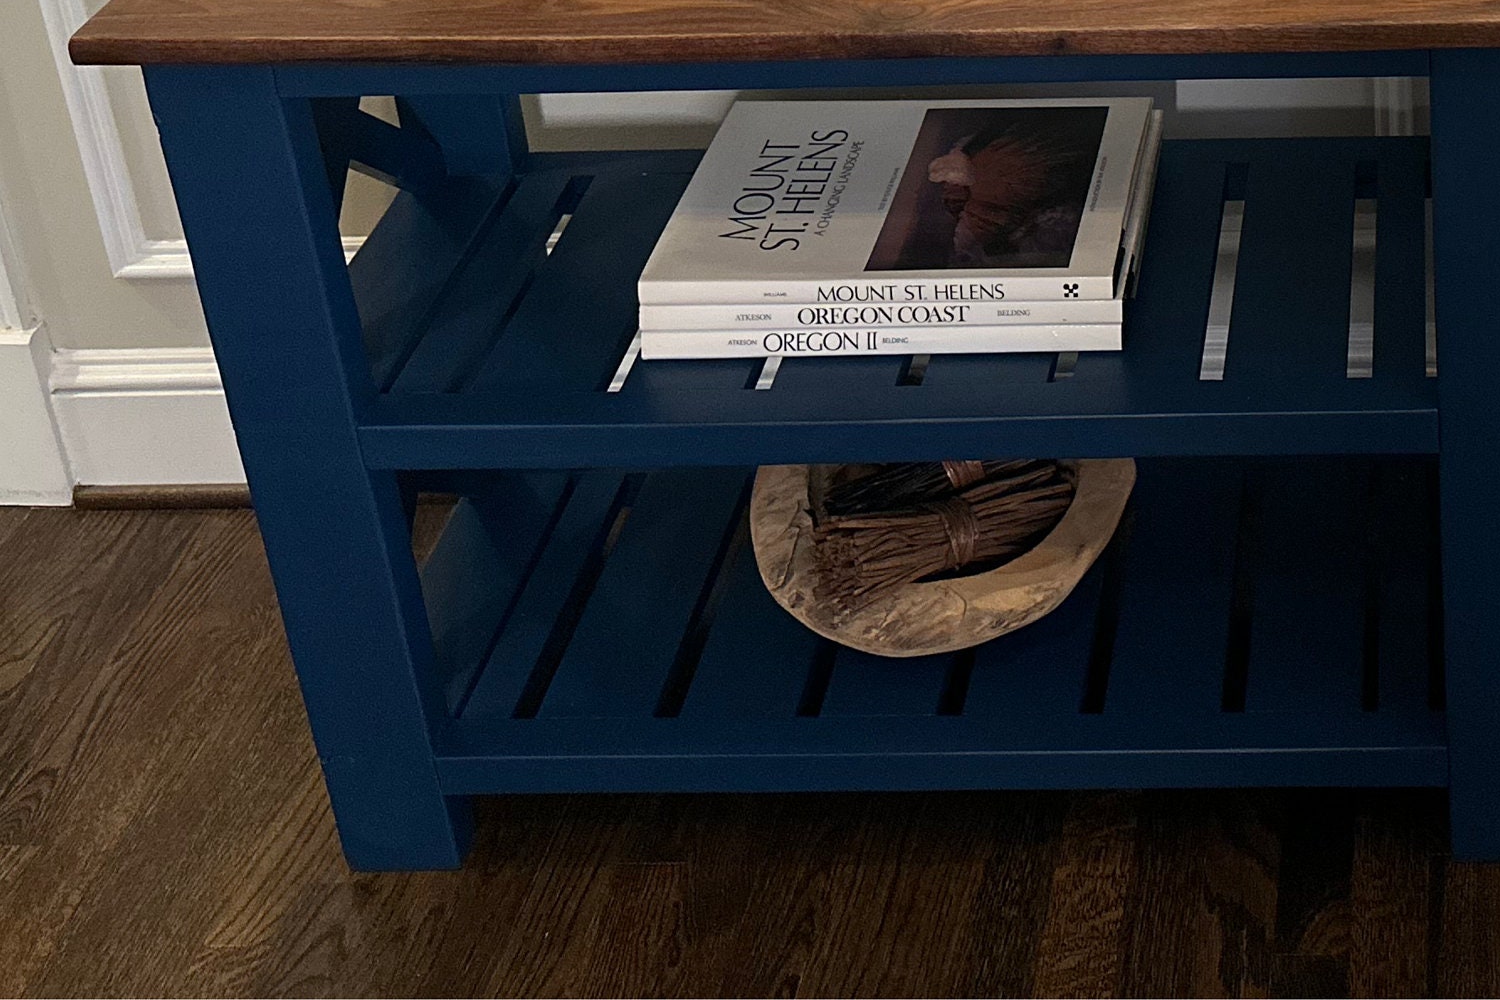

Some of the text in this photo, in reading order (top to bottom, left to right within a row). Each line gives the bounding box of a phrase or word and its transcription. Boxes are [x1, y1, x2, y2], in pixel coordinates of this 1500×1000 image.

[717, 139, 800, 240] MOUNT
[759, 129, 849, 251] ST. HELENS
[816, 184, 845, 229] CHANGING
[837, 140, 866, 184] LANDSCAPE
[817, 284, 1005, 302] MOUNT ST. HELENS
[735, 313, 772, 321] ATKESON
[797, 306, 970, 325] OREGON COAST
[996, 309, 1031, 318] BELDING
[763, 331, 878, 353] OREGON II
[882, 336, 909, 344] BELDING
